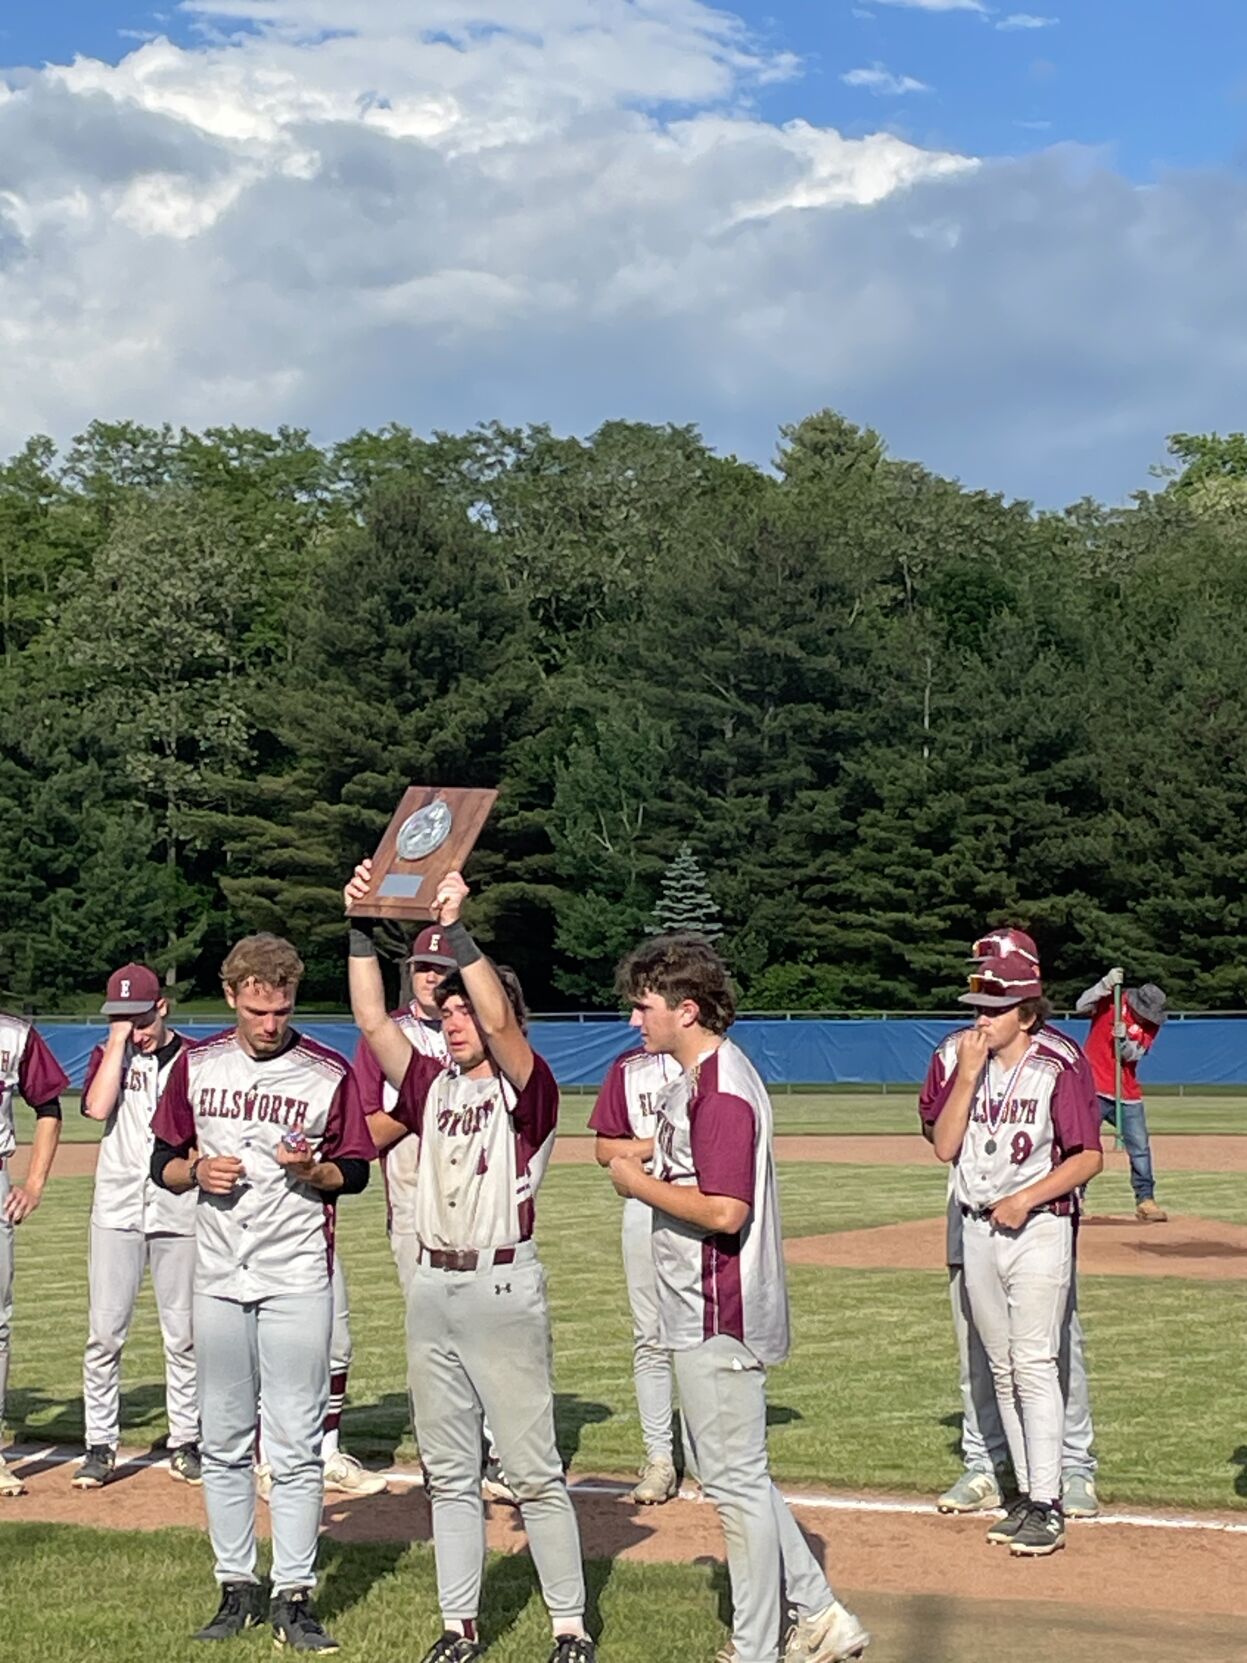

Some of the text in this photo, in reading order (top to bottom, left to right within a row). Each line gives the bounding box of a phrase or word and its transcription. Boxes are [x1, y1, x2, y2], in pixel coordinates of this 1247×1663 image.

[429, 934, 441, 951] E
[120, 979, 131, 998] E
[199, 1087, 309, 1126] ELLSWORTH
[972, 1098, 1039, 1125] LSWORTH
[1010, 1130, 1034, 1165] 9
